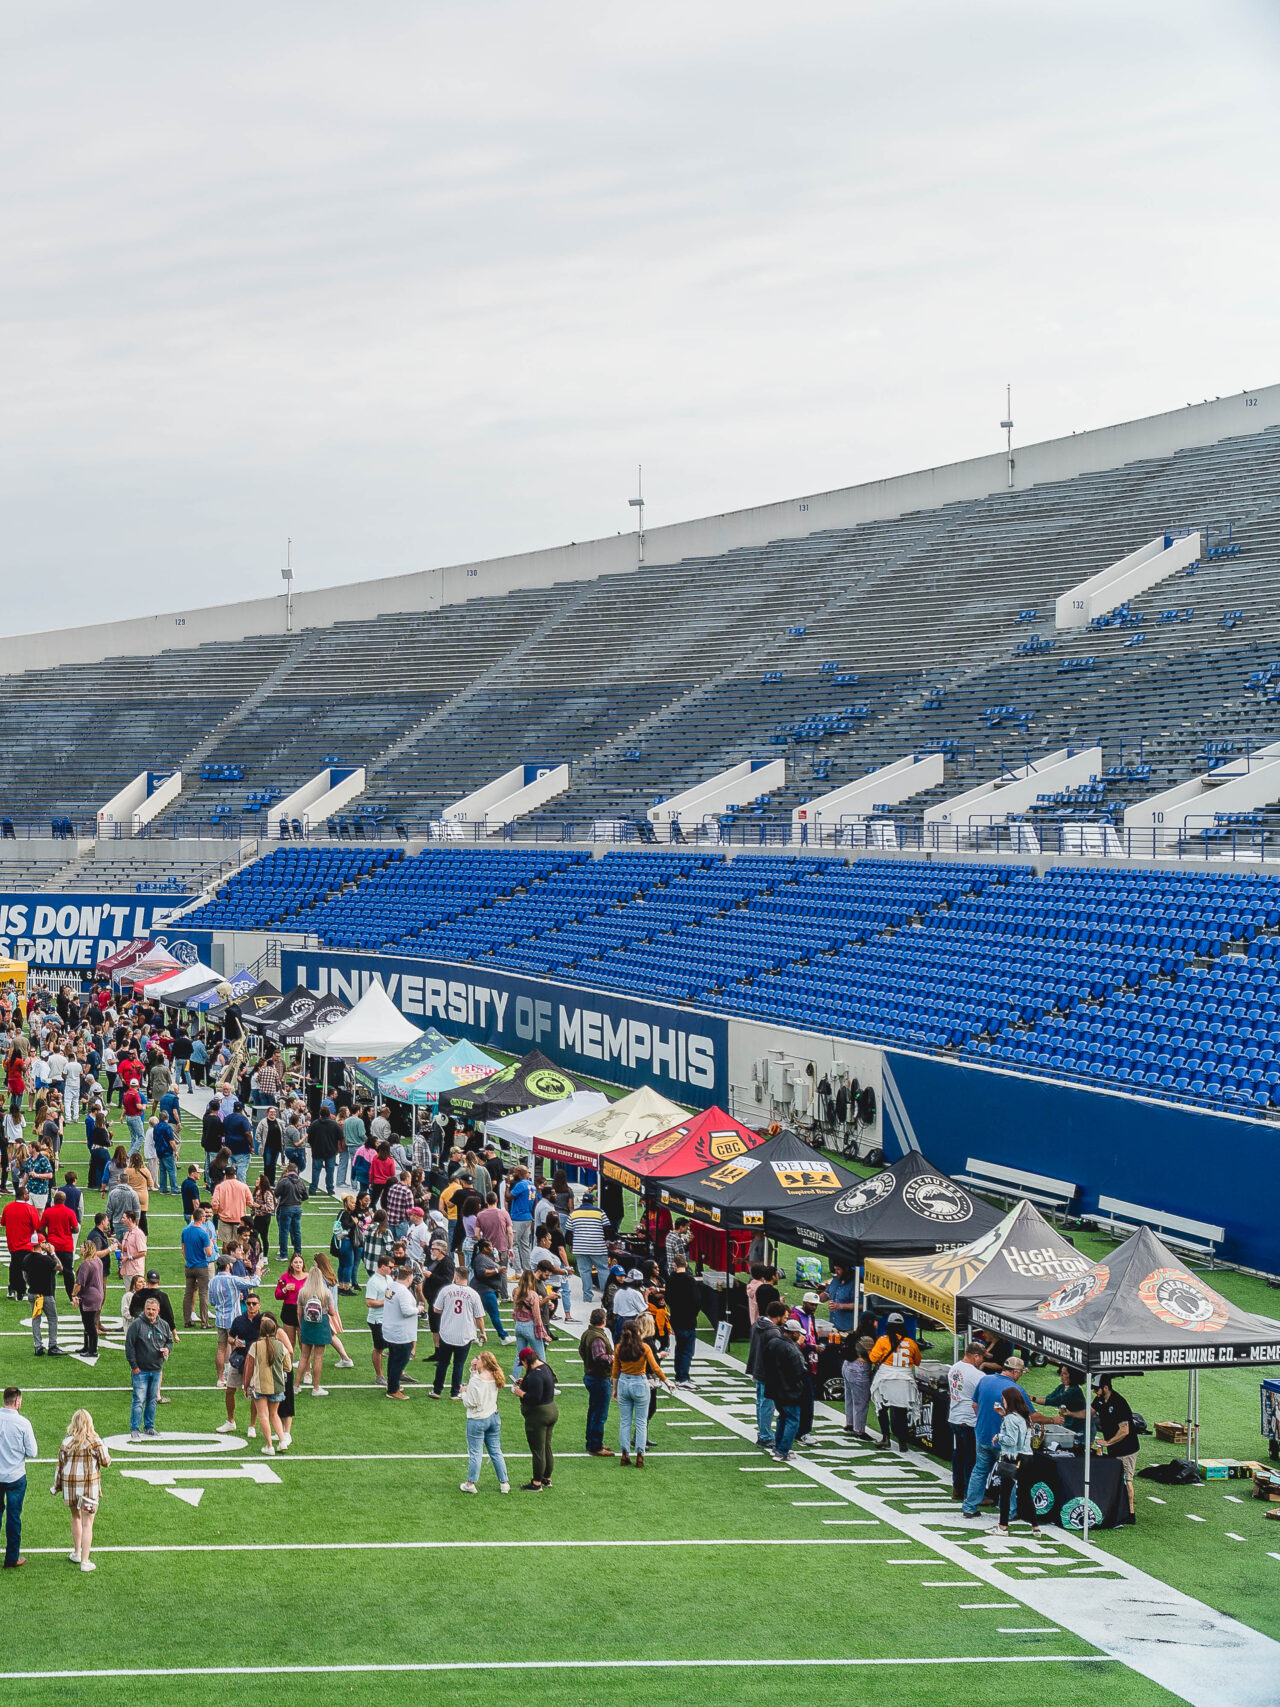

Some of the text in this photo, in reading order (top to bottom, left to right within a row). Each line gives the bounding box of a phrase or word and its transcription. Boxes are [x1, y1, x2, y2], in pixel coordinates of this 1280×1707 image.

[1245, 398, 1257, 406] 132
[1072, 601, 1084, 609] 132
[1152, 812, 1163, 823] 10
[32, 903, 130, 937] DON'T
[17, 938, 100, 965] DRIVE
[30, 968, 80, 979] HIGHWAY
[297, 966, 509, 1032] UNIVERSITY
[515, 996, 551, 1043] OF
[559, 1005, 714, 1089] MEMPHIS
[717, 1142, 741, 1155] CBC
[776, 1162, 829, 1172] BELL'S
[906, 1176, 962, 1199] DESCHUTES
[923, 1210, 966, 1220] BREWERY
[796, 1227, 825, 1242] DESCHUTES
[1000, 1246, 1057, 1272] HIGH
[1018, 1257, 1089, 1276] COTTON
[864, 1272, 953, 1317] HIGH COTTON BREWING CO.
[455, 1300, 463, 1314] 3
[972, 1307, 1083, 1363] WISEACRE BREWING CO. MEMPHIS, TN
[893, 1349, 910, 1367] 16
[1100, 1351, 1160, 1365] WISEACRE
[1163, 1348, 1215, 1363] BREWING
[1219, 1348, 1237, 1360] CO.
